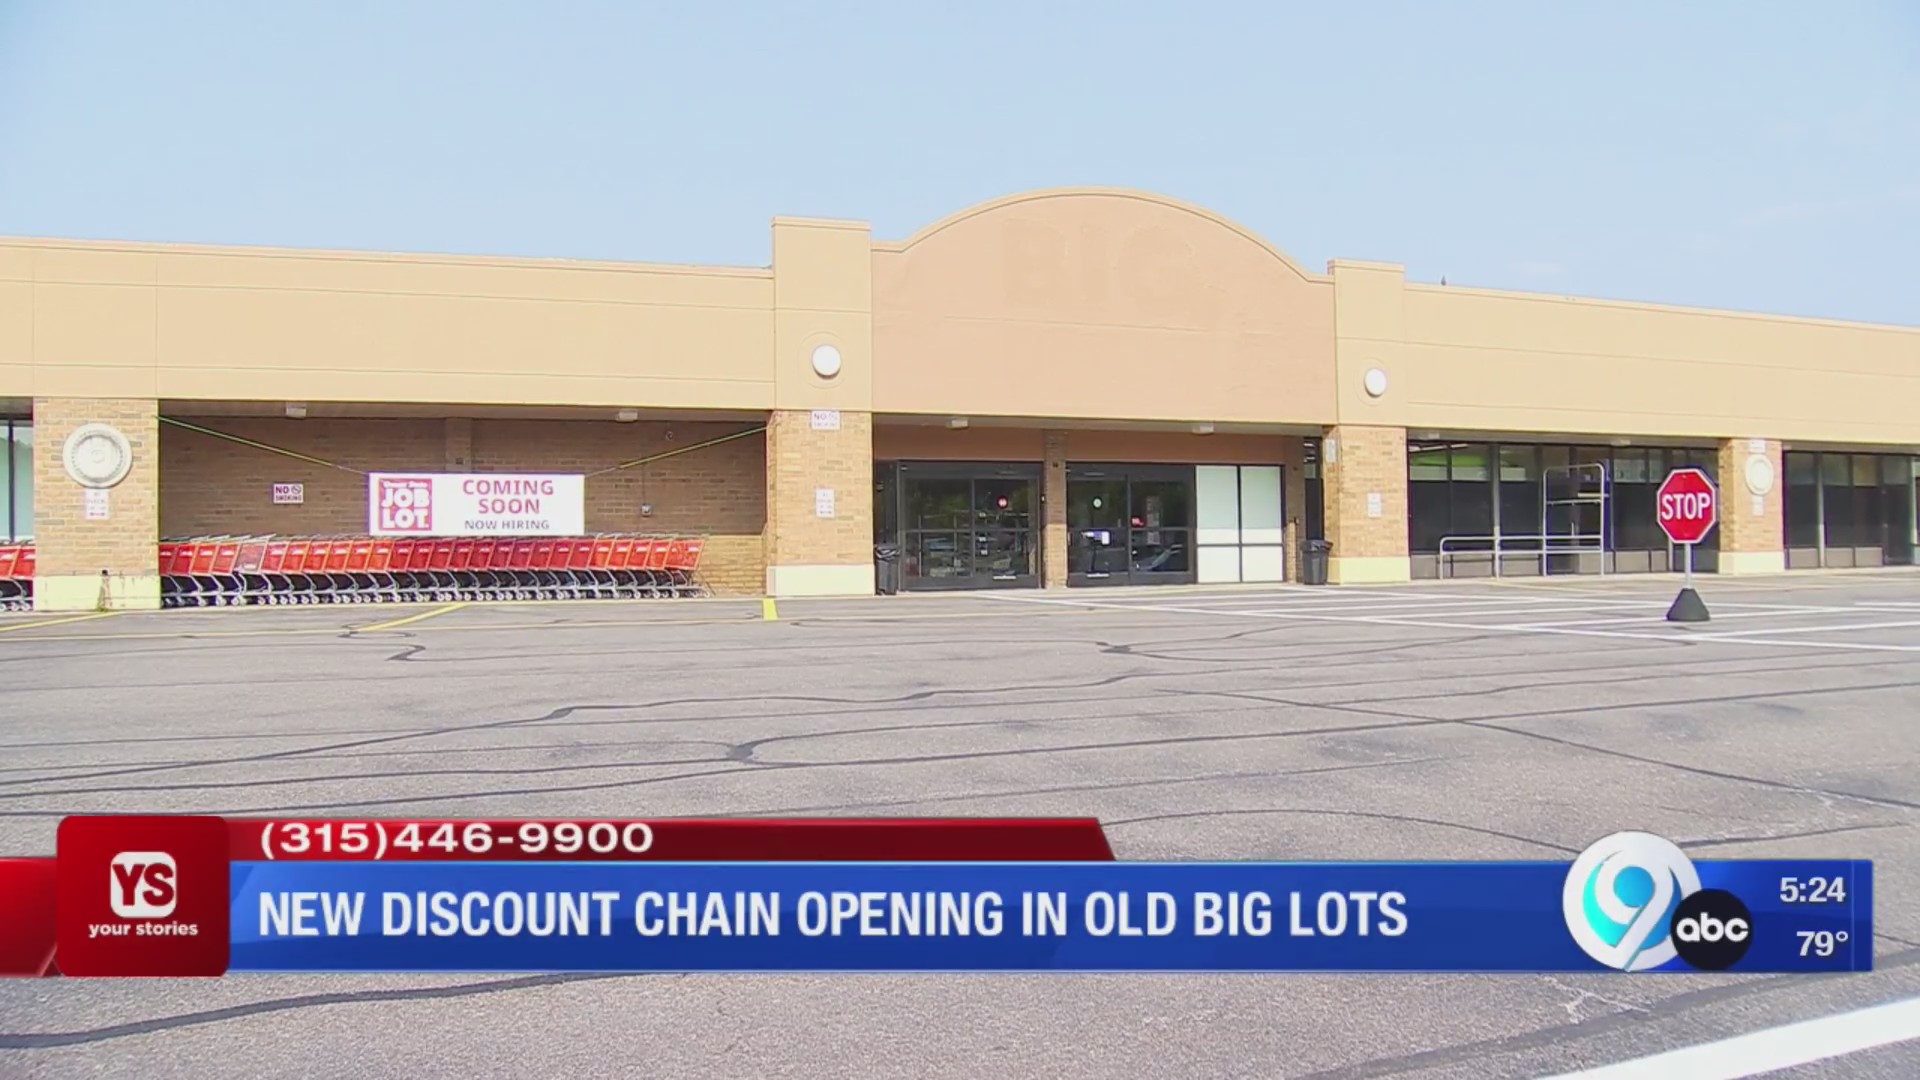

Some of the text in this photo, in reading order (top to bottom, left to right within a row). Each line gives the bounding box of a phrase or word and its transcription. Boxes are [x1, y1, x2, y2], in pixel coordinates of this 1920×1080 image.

[275, 486, 290, 494] NO
[463, 479, 554, 495] COMING
[381, 488, 430, 508] JOB
[478, 498, 540, 514] SOON
[1661, 493, 1711, 520] STOP
[464, 520, 550, 530] NOW HIRING
